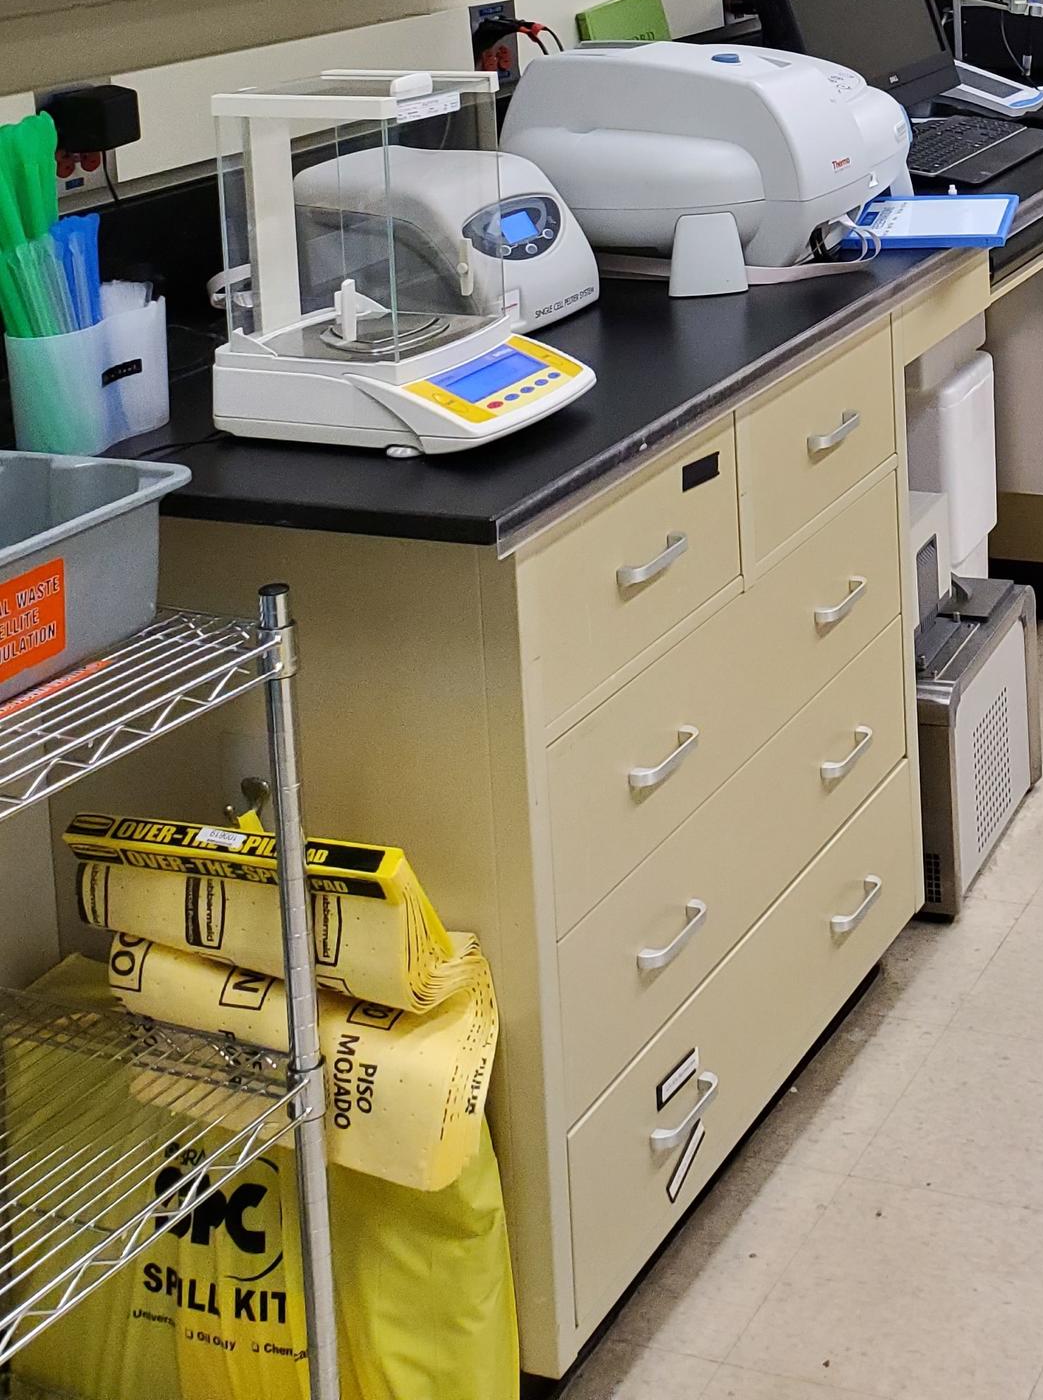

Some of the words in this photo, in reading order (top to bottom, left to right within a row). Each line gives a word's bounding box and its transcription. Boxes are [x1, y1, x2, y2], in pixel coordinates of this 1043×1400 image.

[16, 575, 60, 609] WASTE
[0, 622, 56, 664] ULATION
[126, 850, 280, 885] OVER-THE-SPI
[206, 878, 215, 942] ubbermaid
[333, 1033, 360, 1130] MOJADO
[356, 1062, 378, 1114] PISO
[154, 1166, 268, 1254] SPC
[143, 1262, 222, 1320] SPILL
[234, 1287, 288, 1325] KIT
